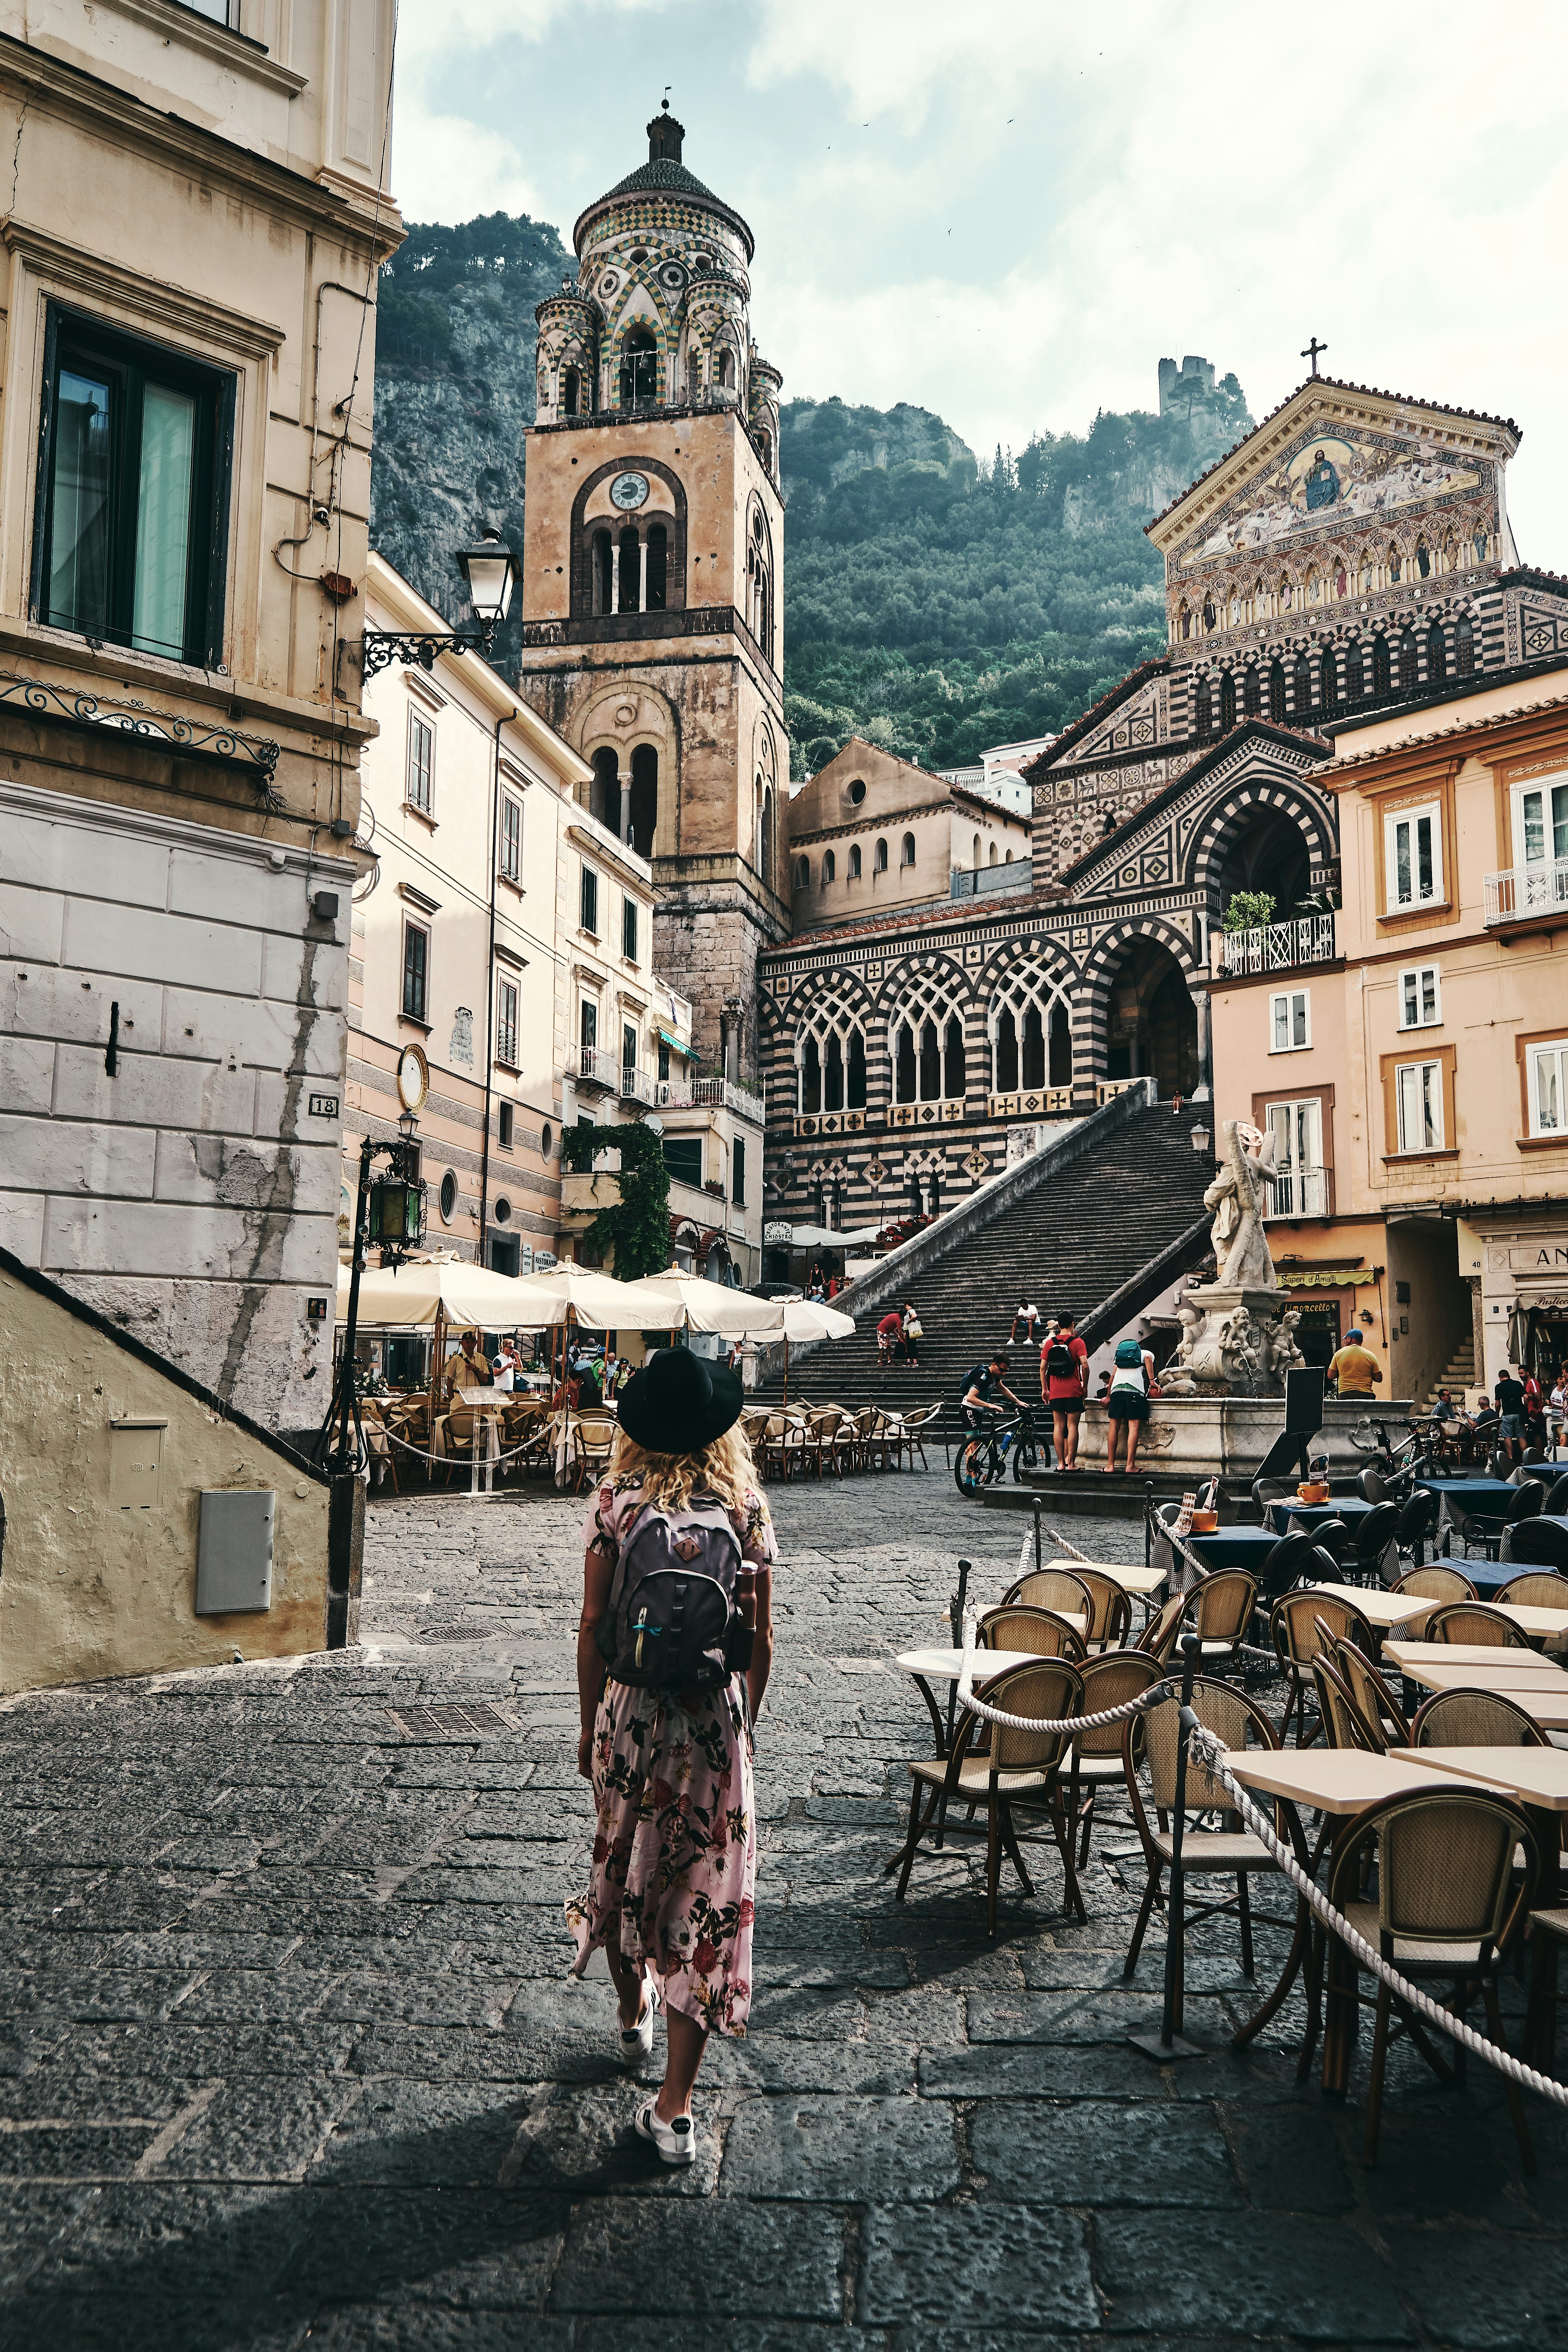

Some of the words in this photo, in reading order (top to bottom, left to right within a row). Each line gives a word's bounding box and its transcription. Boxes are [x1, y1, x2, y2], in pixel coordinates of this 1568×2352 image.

[316, 1099, 334, 1113] 18
[766, 1222, 790, 1234] RISTORANTE
[535, 1257, 557, 1266] RISTORANTE
[1281, 1275, 1305, 1285] Sapori
[1308, 1274, 1336, 1283] d'Amalfi
[1534, 1296, 1568, 1305] Pasticc
[1285, 1303, 1330, 1312] Limoncello
[966, 1410, 977, 1427] BORA
